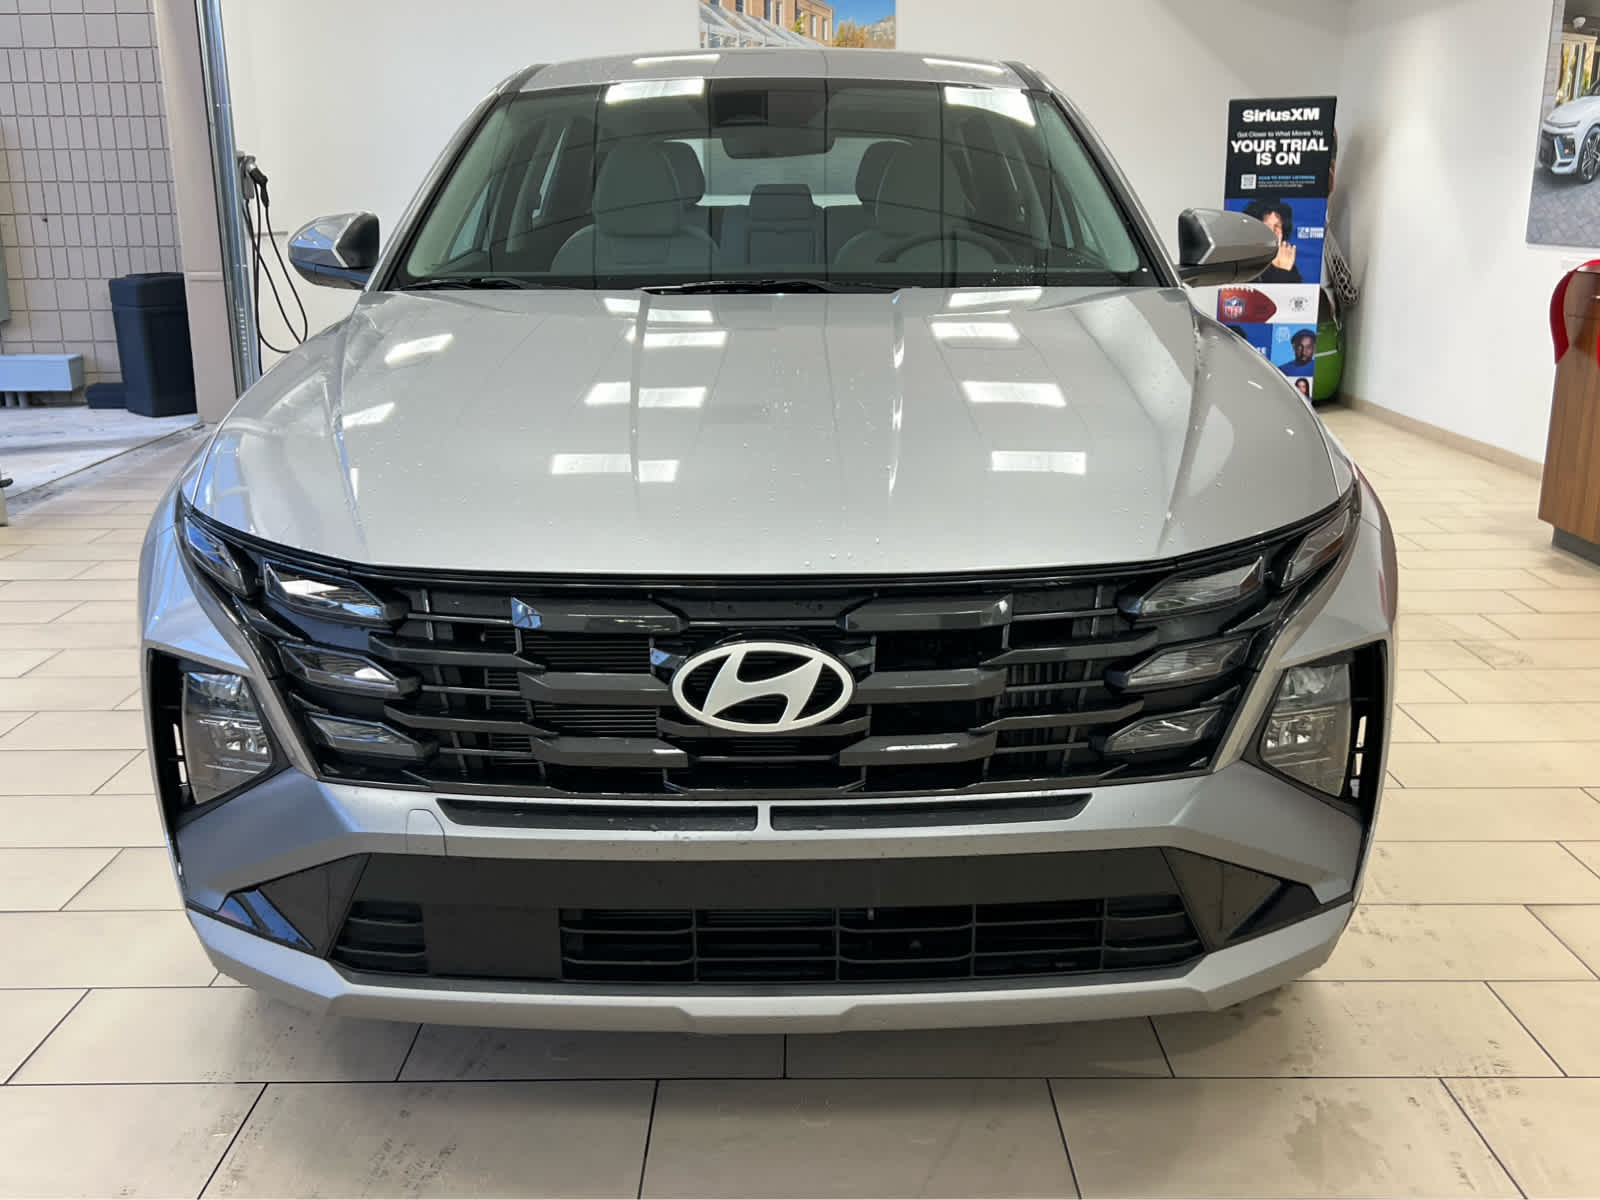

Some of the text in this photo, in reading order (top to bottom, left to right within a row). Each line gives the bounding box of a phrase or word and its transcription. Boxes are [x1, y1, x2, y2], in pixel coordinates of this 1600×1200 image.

[1242, 107, 1320, 122] SiriusXM
[1231, 138, 1329, 153] YOUR TRIAL
[1256, 152, 1301, 166] IS ON
